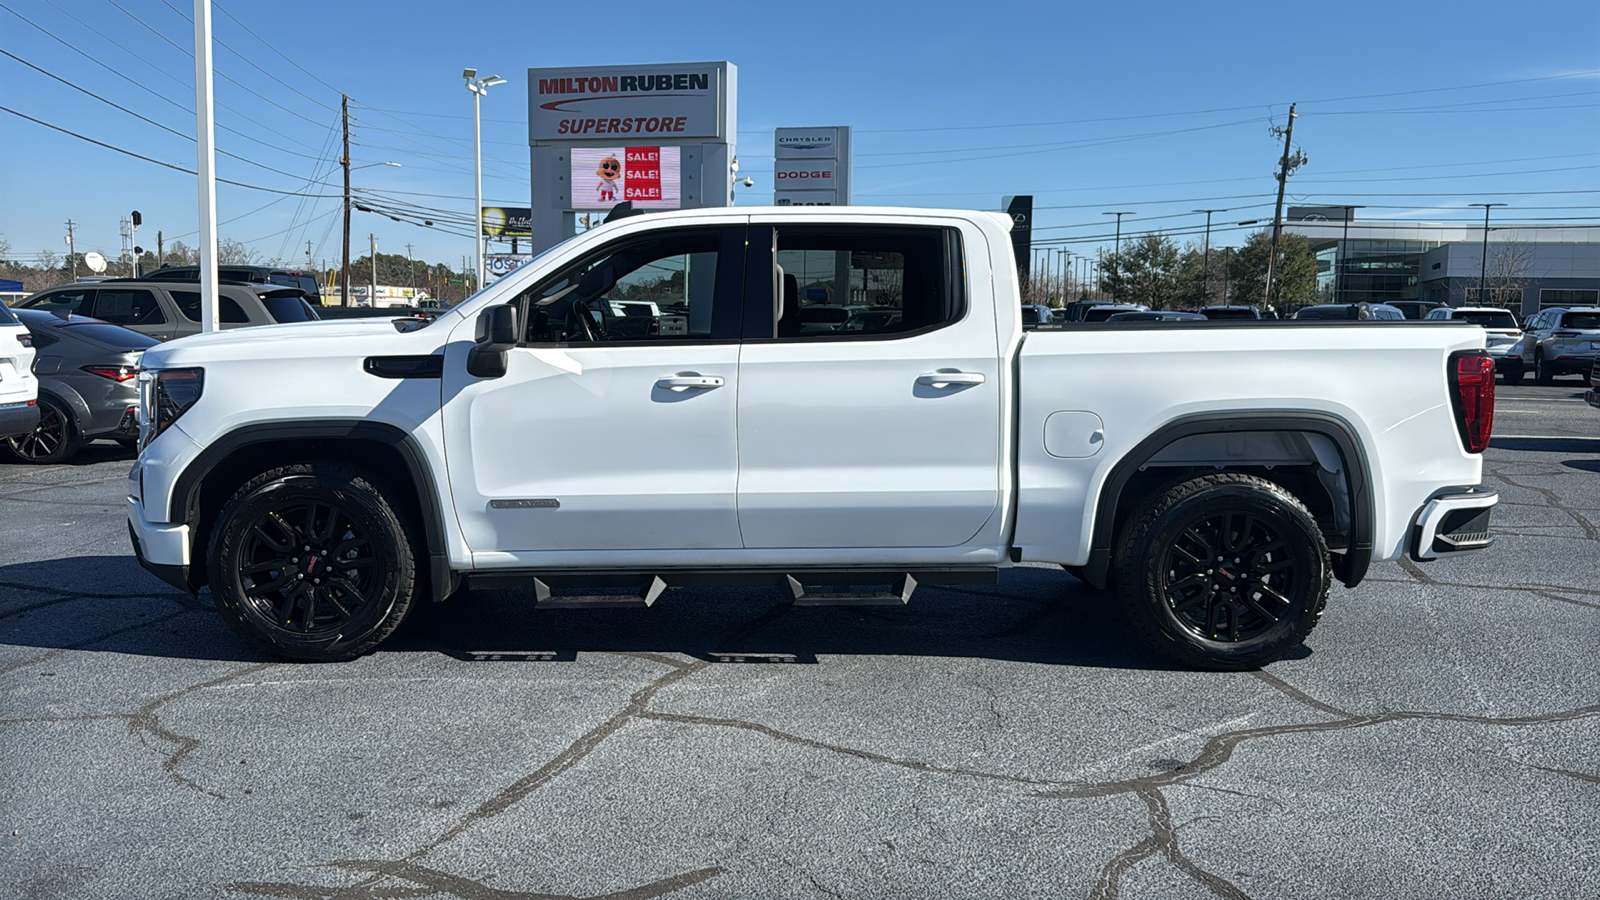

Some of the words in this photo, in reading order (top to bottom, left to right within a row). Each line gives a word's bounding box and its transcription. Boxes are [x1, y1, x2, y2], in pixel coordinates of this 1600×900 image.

[539, 76, 618, 95] MILTON
[620, 73, 709, 92] RUBEN
[557, 117, 688, 135] SUPERSTORE
[626, 151, 659, 162] SALE!
[626, 169, 659, 180] SALE!
[777, 170, 832, 180] DODGE
[626, 187, 660, 198] SALE!
